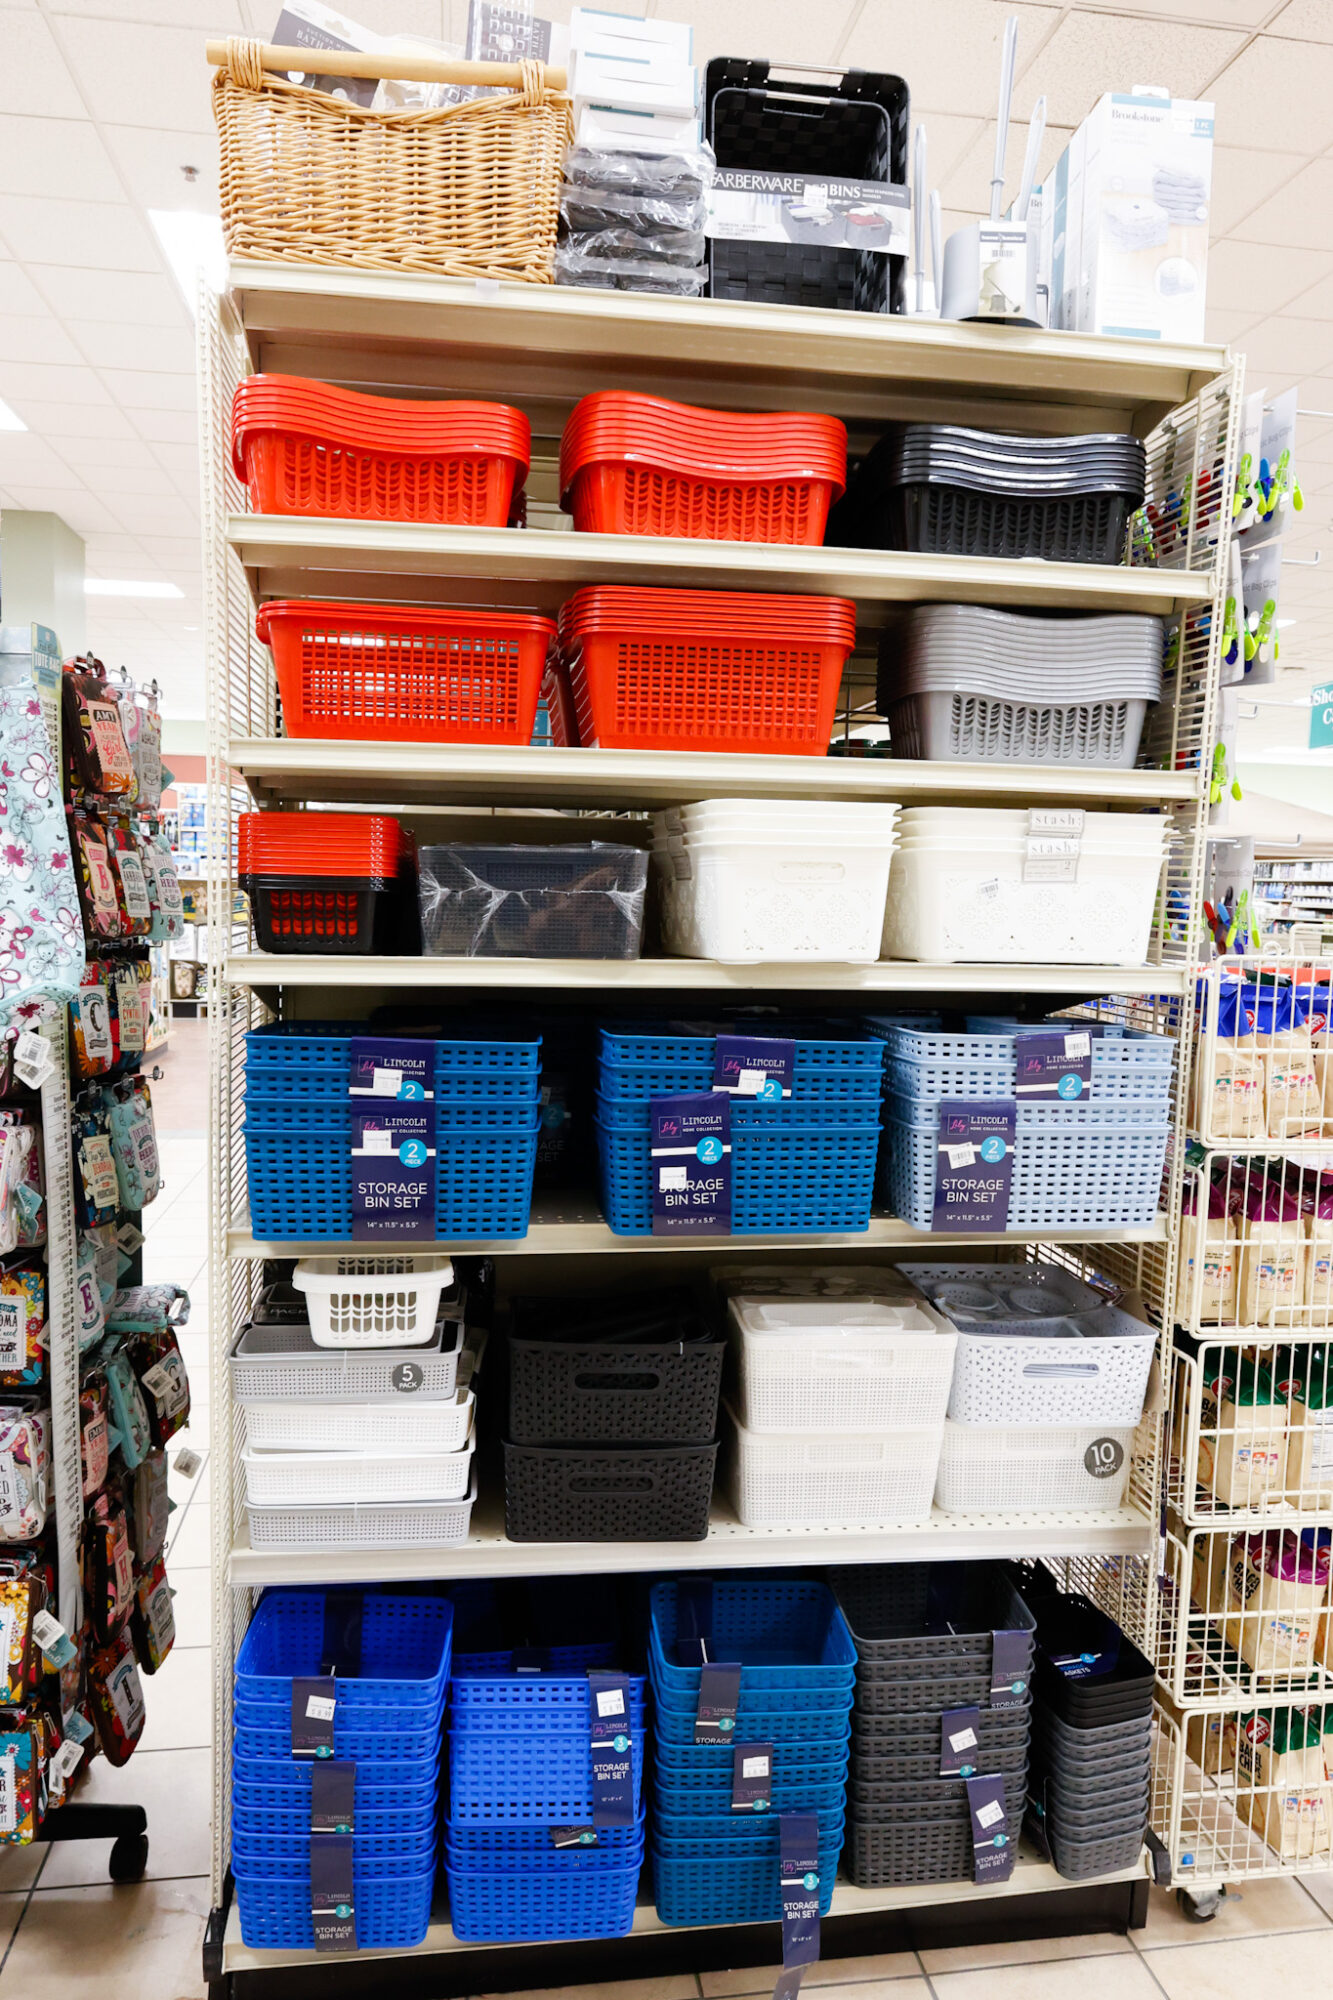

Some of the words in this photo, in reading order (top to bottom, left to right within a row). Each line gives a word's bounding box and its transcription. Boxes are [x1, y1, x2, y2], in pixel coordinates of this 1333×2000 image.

[296, 29, 324, 49] BATH
[711, 172, 804, 193] FARBERWARE
[829, 184, 861, 199] BINS
[95, 710, 116, 722] AMY
[1322, 707, 1333, 726] C
[97, 863, 109, 890] B
[383, 1058, 426, 1068] LINCOLN
[746, 1057, 786, 1068] LINCOLN
[1064, 1077, 1075, 1091] 2
[404, 1084, 416, 1100] 2
[764, 1083, 775, 1098] 2
[385, 1118, 427, 1126] LINCOLN
[682, 1116, 722, 1126] LINCOLN
[970, 1116, 1008, 1124] LINCOLN
[407, 1143, 418, 1158] 2
[704, 1140, 715, 1155] 2
[988, 1139, 999, 1154] 2
[358, 1182, 428, 1195] STORAGE
[942, 1178, 1004, 1190] STORAGE
[365, 1196, 389, 1208] BIN
[394, 1196, 421, 1208] SET
[665, 1194, 688, 1206] BIN
[692, 1192, 718, 1205] SET
[946, 1192, 969, 1203] BIN
[972, 1192, 997, 1203] SET
[80, 1282, 95, 1314] E
[402, 1365, 414, 1381] 5
[399, 1381, 418, 1389] PACK
[1091, 1442, 1115, 1466] 10
[1094, 1462, 1117, 1475] PACK
[1064, 1666, 1091, 1677] ASKETS
[617, 1737, 624, 1747] 3
[320, 1746, 327, 1754] 3
[1239, 1739, 1262, 1768] BAEL
[593, 1762, 630, 1772] STORAGE
[1239, 1753, 1262, 1780] CHPS
[597, 1773, 611, 1781] BIN
[612, 1771, 627, 1780] SET
[976, 1851, 1008, 1865] STORAGE
[979, 1862, 991, 1870] BIN
[992, 1858, 1005, 1867] SET
[807, 1875, 814, 1885] 3
[340, 1905, 346, 1915] 3
[784, 1901, 819, 1911] STORAGE
[787, 1911, 801, 1920] BIN
[802, 1910, 816, 1919] SET
[315, 1926, 353, 1934] STORAGE
